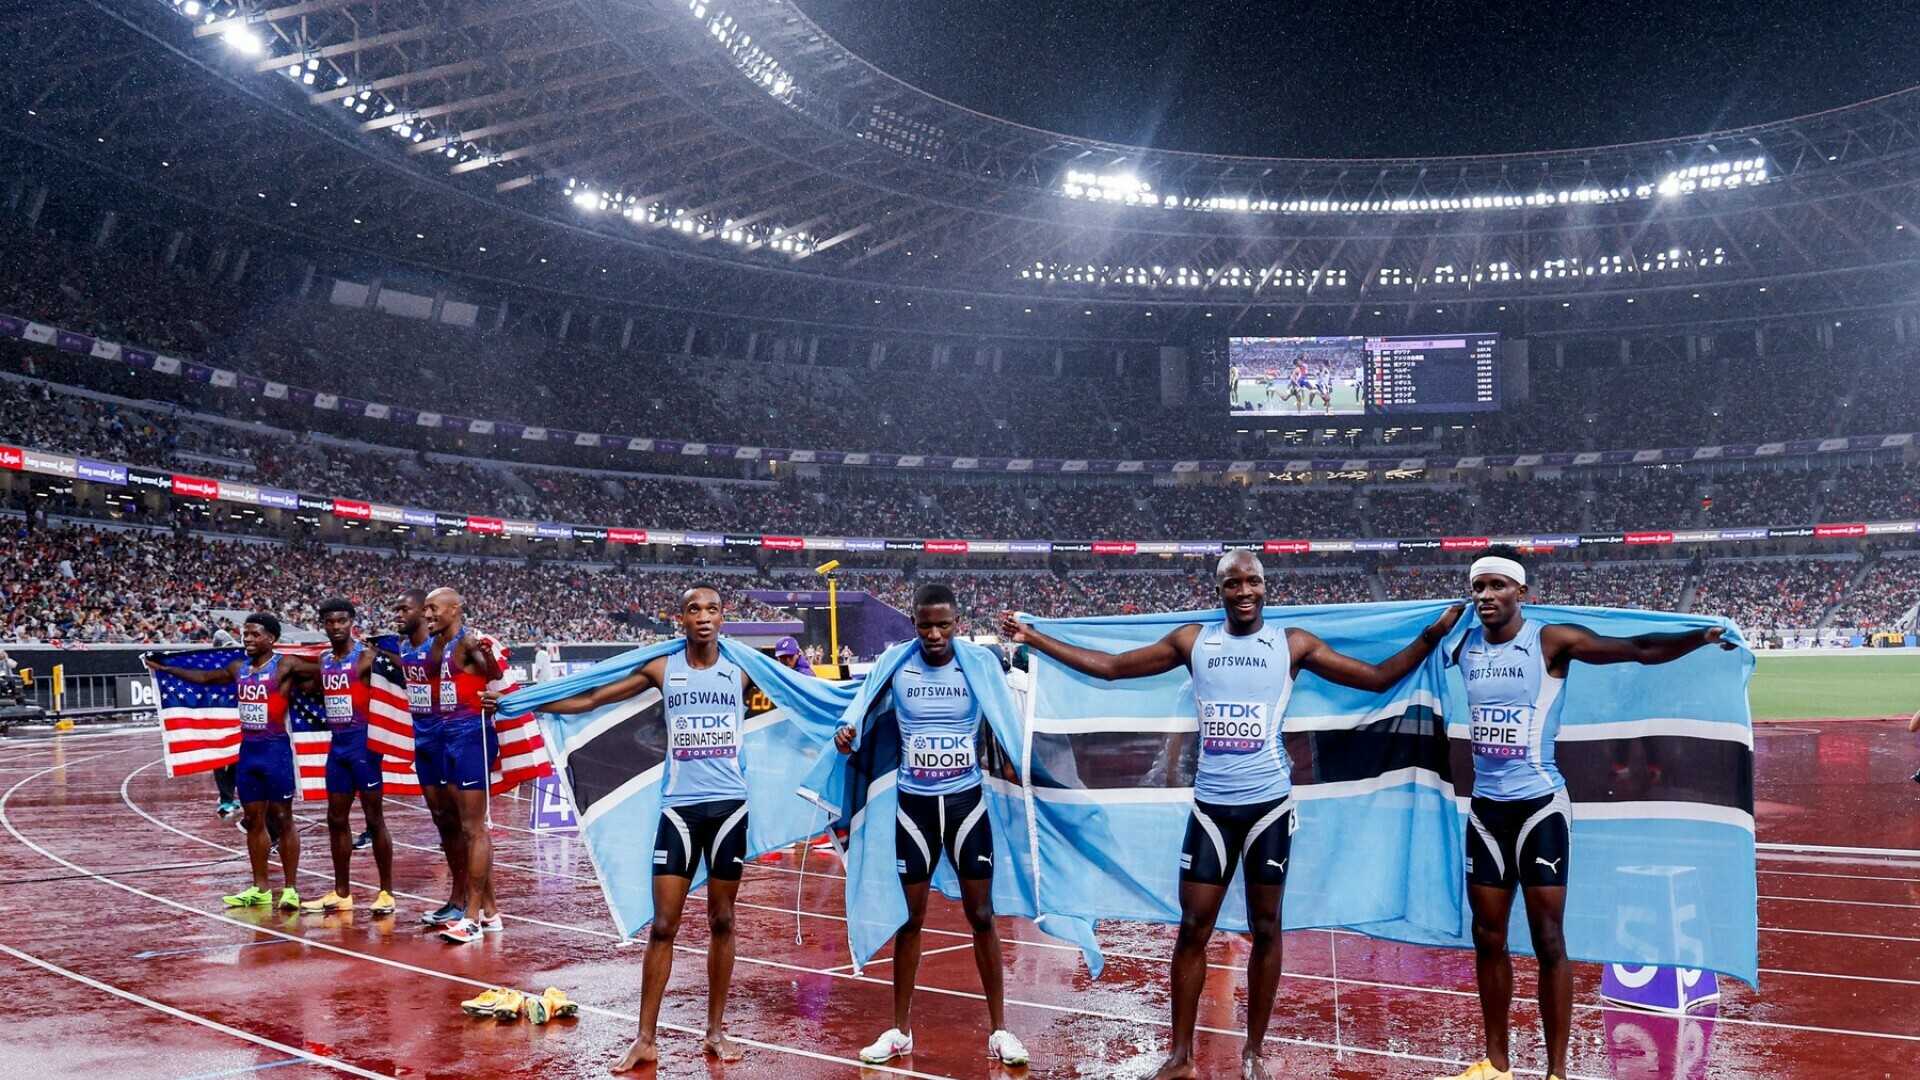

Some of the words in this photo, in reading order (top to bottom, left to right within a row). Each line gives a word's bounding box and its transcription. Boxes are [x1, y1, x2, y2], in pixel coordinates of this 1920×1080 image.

[1208, 656, 1267, 668] BOTSWANA
[402, 665, 429, 681] USA
[1469, 667, 1524, 681] BOTSWANA
[323, 673, 350, 690] USA
[238, 684, 268, 700] USA
[907, 686, 969, 698] BOTSWANA
[668, 691, 736, 709] BOTSWANA
[243, 704, 263, 712] TDK
[1215, 704, 1260, 718] TDK
[687, 715, 730, 729] TDK
[1480, 708, 1522, 724] TDK
[1204, 722, 1262, 737] TEBOGO
[1473, 726, 1517, 744] EPPIE
[673, 731, 734, 746] KEBINATSHIPI
[926, 736, 968, 750] TDK
[914, 752, 970, 767] NDORI
[542, 783, 574, 820] 4
